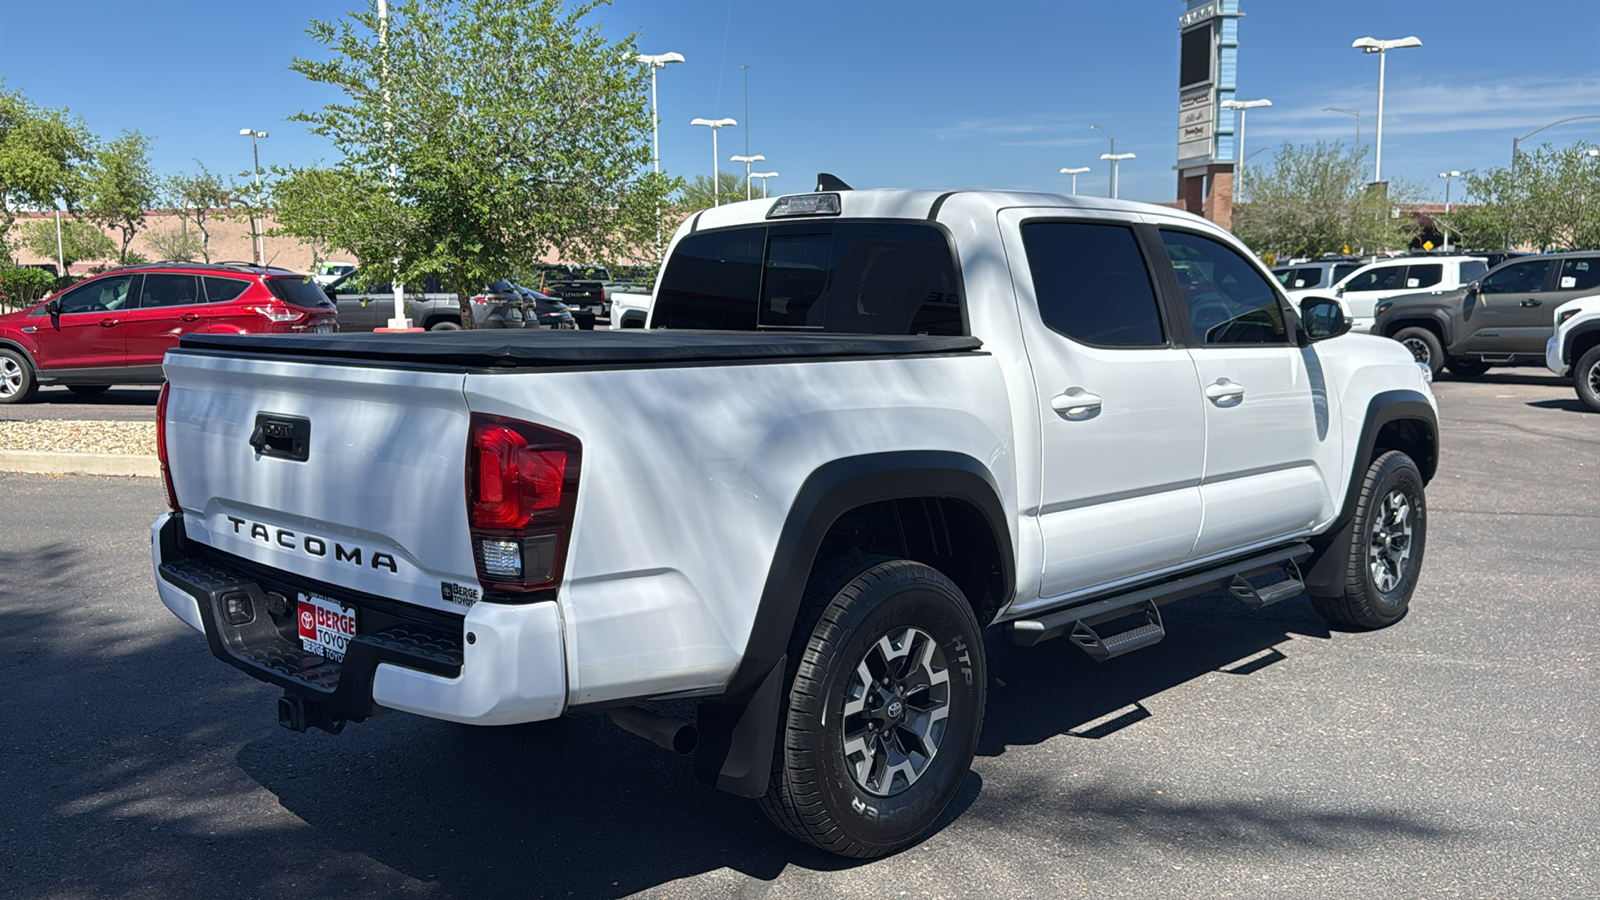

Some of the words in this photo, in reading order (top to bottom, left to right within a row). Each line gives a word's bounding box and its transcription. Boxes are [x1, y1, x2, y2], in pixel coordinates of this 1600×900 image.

[226, 515, 398, 574] TACOMA
[452, 582, 478, 599] BERGE
[317, 606, 355, 635] BERGE
[303, 639, 324, 657] BERGE
[325, 648, 345, 663] TOYO
[317, 629, 351, 650] TOYOT
[951, 634, 973, 686] HTP
